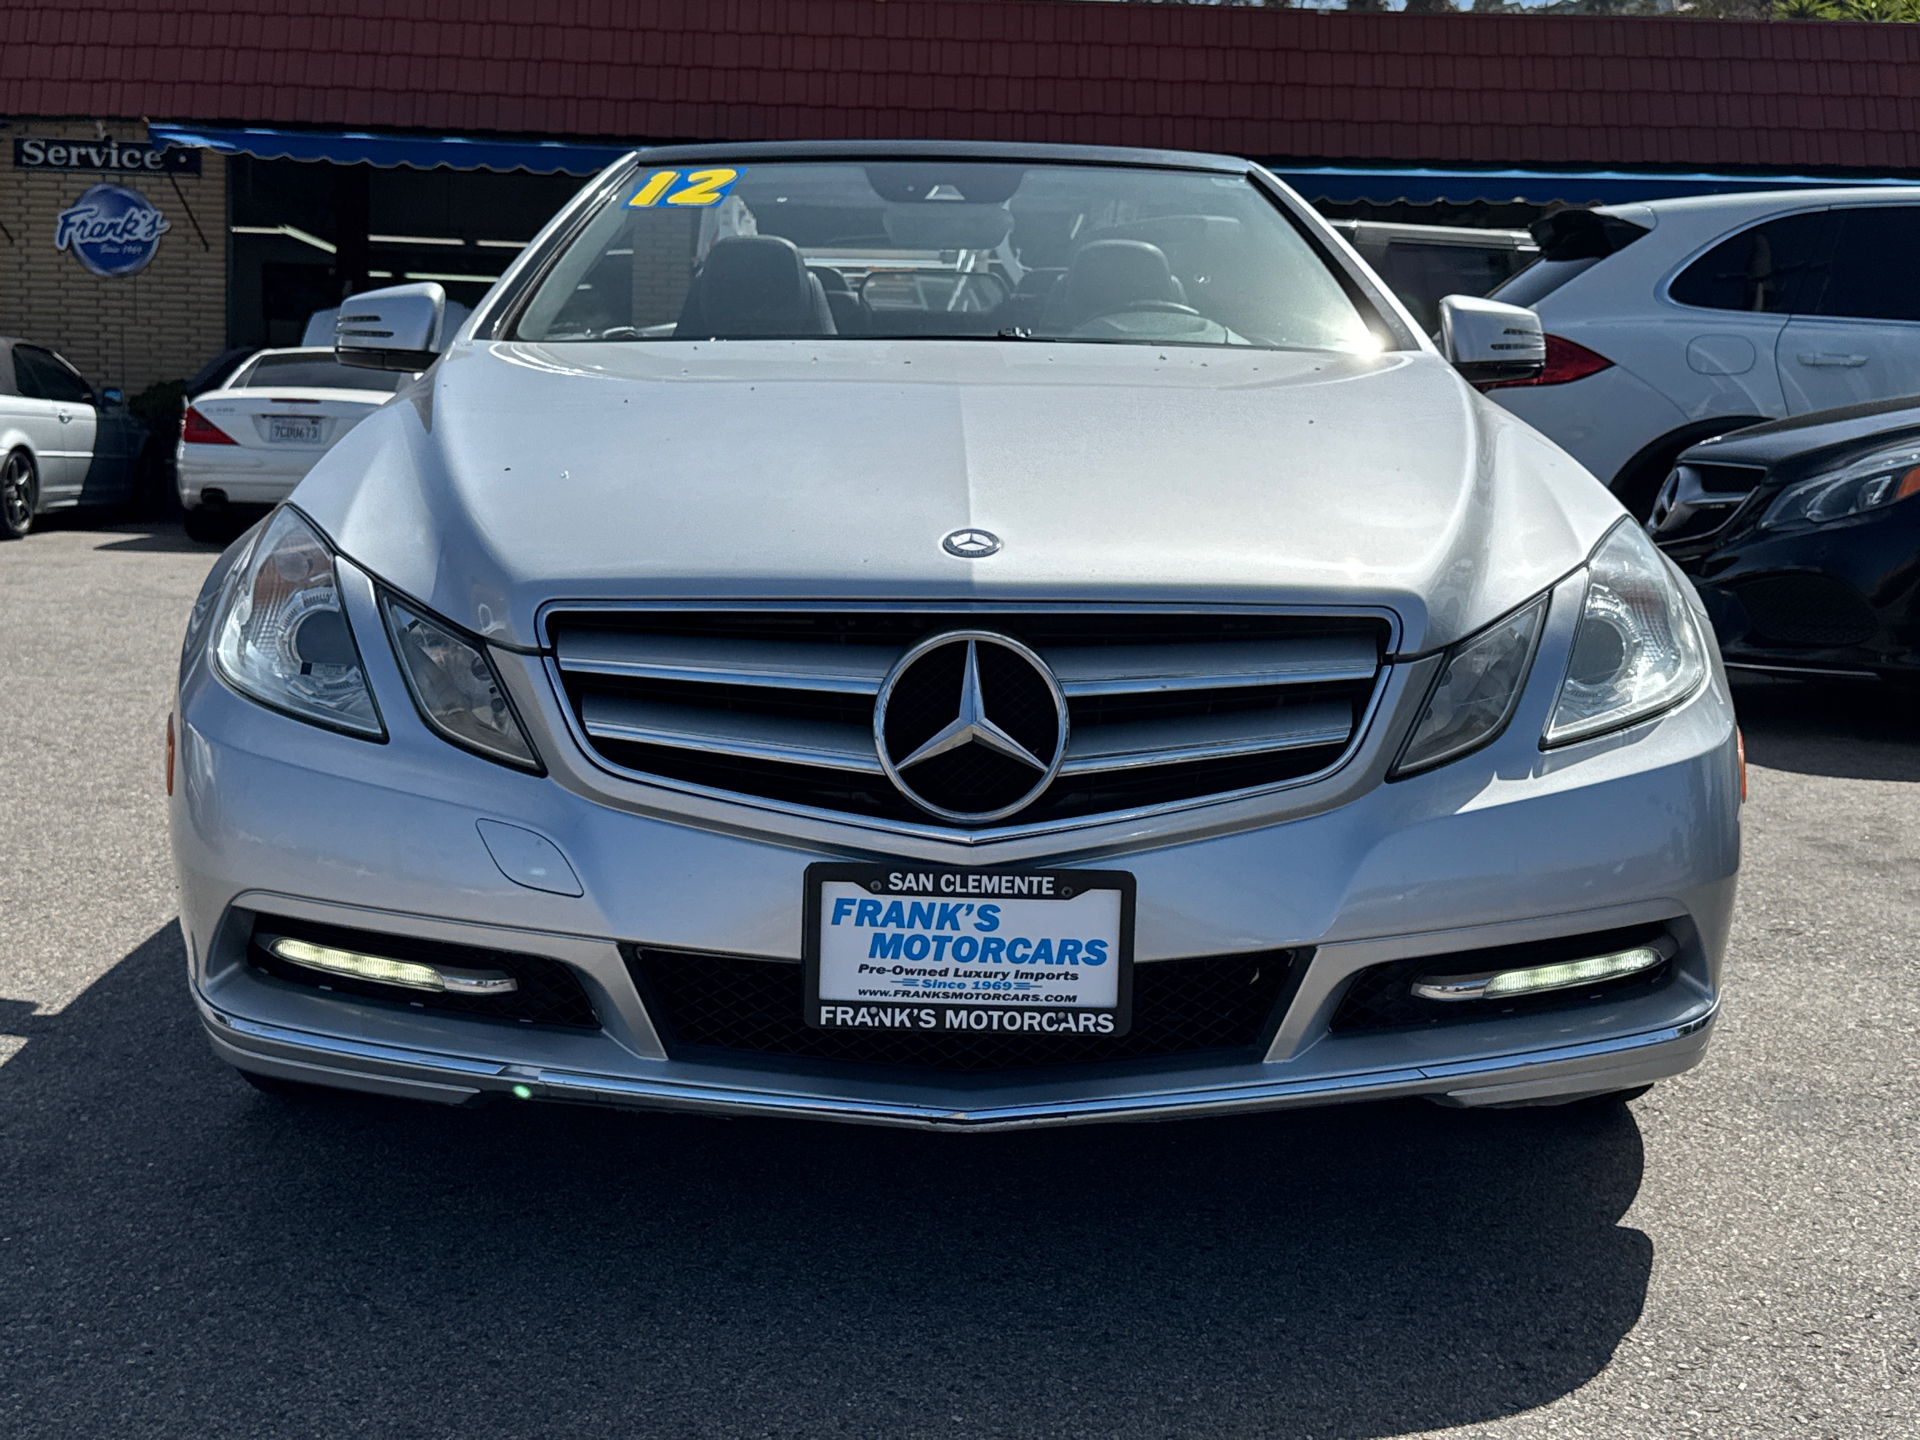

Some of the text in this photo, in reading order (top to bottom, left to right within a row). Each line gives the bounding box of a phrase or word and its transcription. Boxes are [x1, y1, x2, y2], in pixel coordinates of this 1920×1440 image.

[22, 139, 164, 168] Service
[629, 169, 737, 206] 12
[56, 205, 171, 250] Frank's
[888, 872, 1055, 895] SAN CLEMENTE
[831, 898, 1001, 932] FRANK'S
[868, 932, 1109, 966] MOTORCARS
[858, 963, 1079, 982] Pre-Owned Luxury Imports
[921, 978, 1013, 991] Since 1969
[819, 1006, 1115, 1034] FRANK'S MOTORCARS
